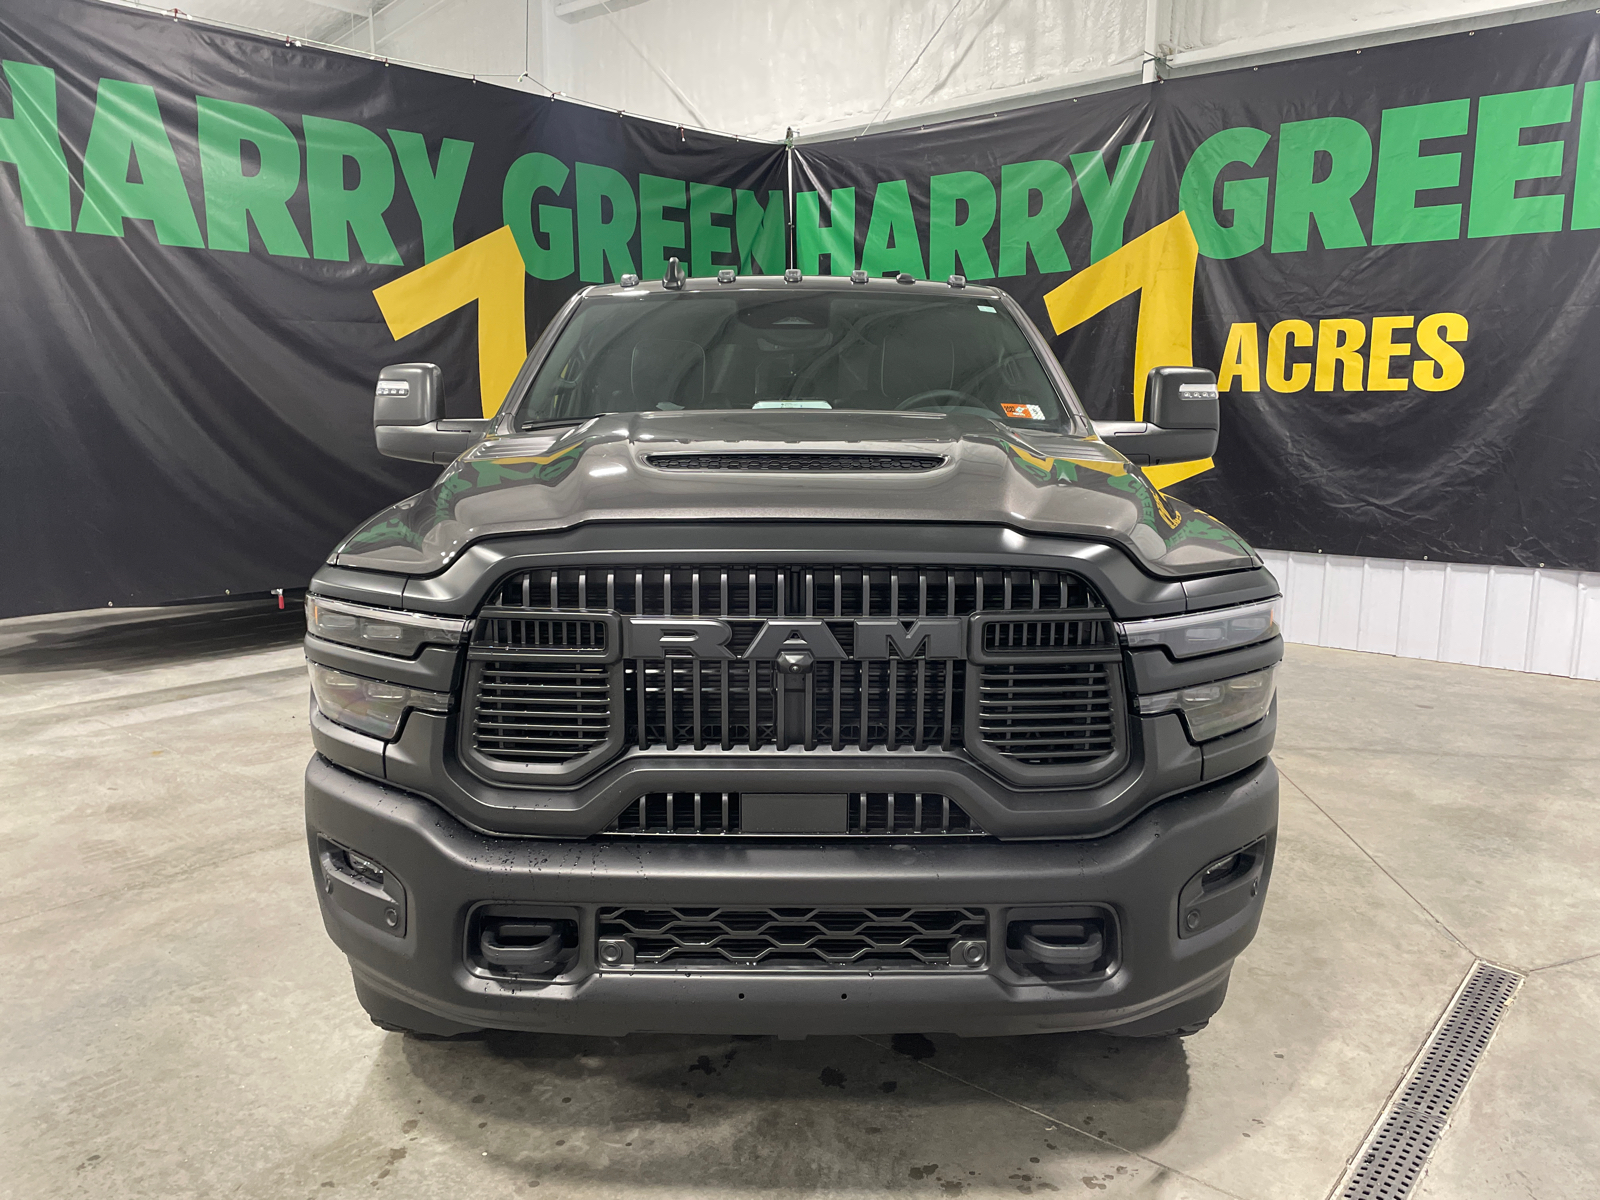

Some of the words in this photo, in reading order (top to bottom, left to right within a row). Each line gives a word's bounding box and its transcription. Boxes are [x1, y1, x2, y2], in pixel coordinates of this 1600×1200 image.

[0, 59, 474, 266] HARRY
[502, 152, 787, 283] GREEN
[795, 140, 1154, 282] HARRY
[1179, 80, 1600, 259] GREE
[1217, 313, 1469, 393] ACRES
[629, 618, 963, 661] RAM
